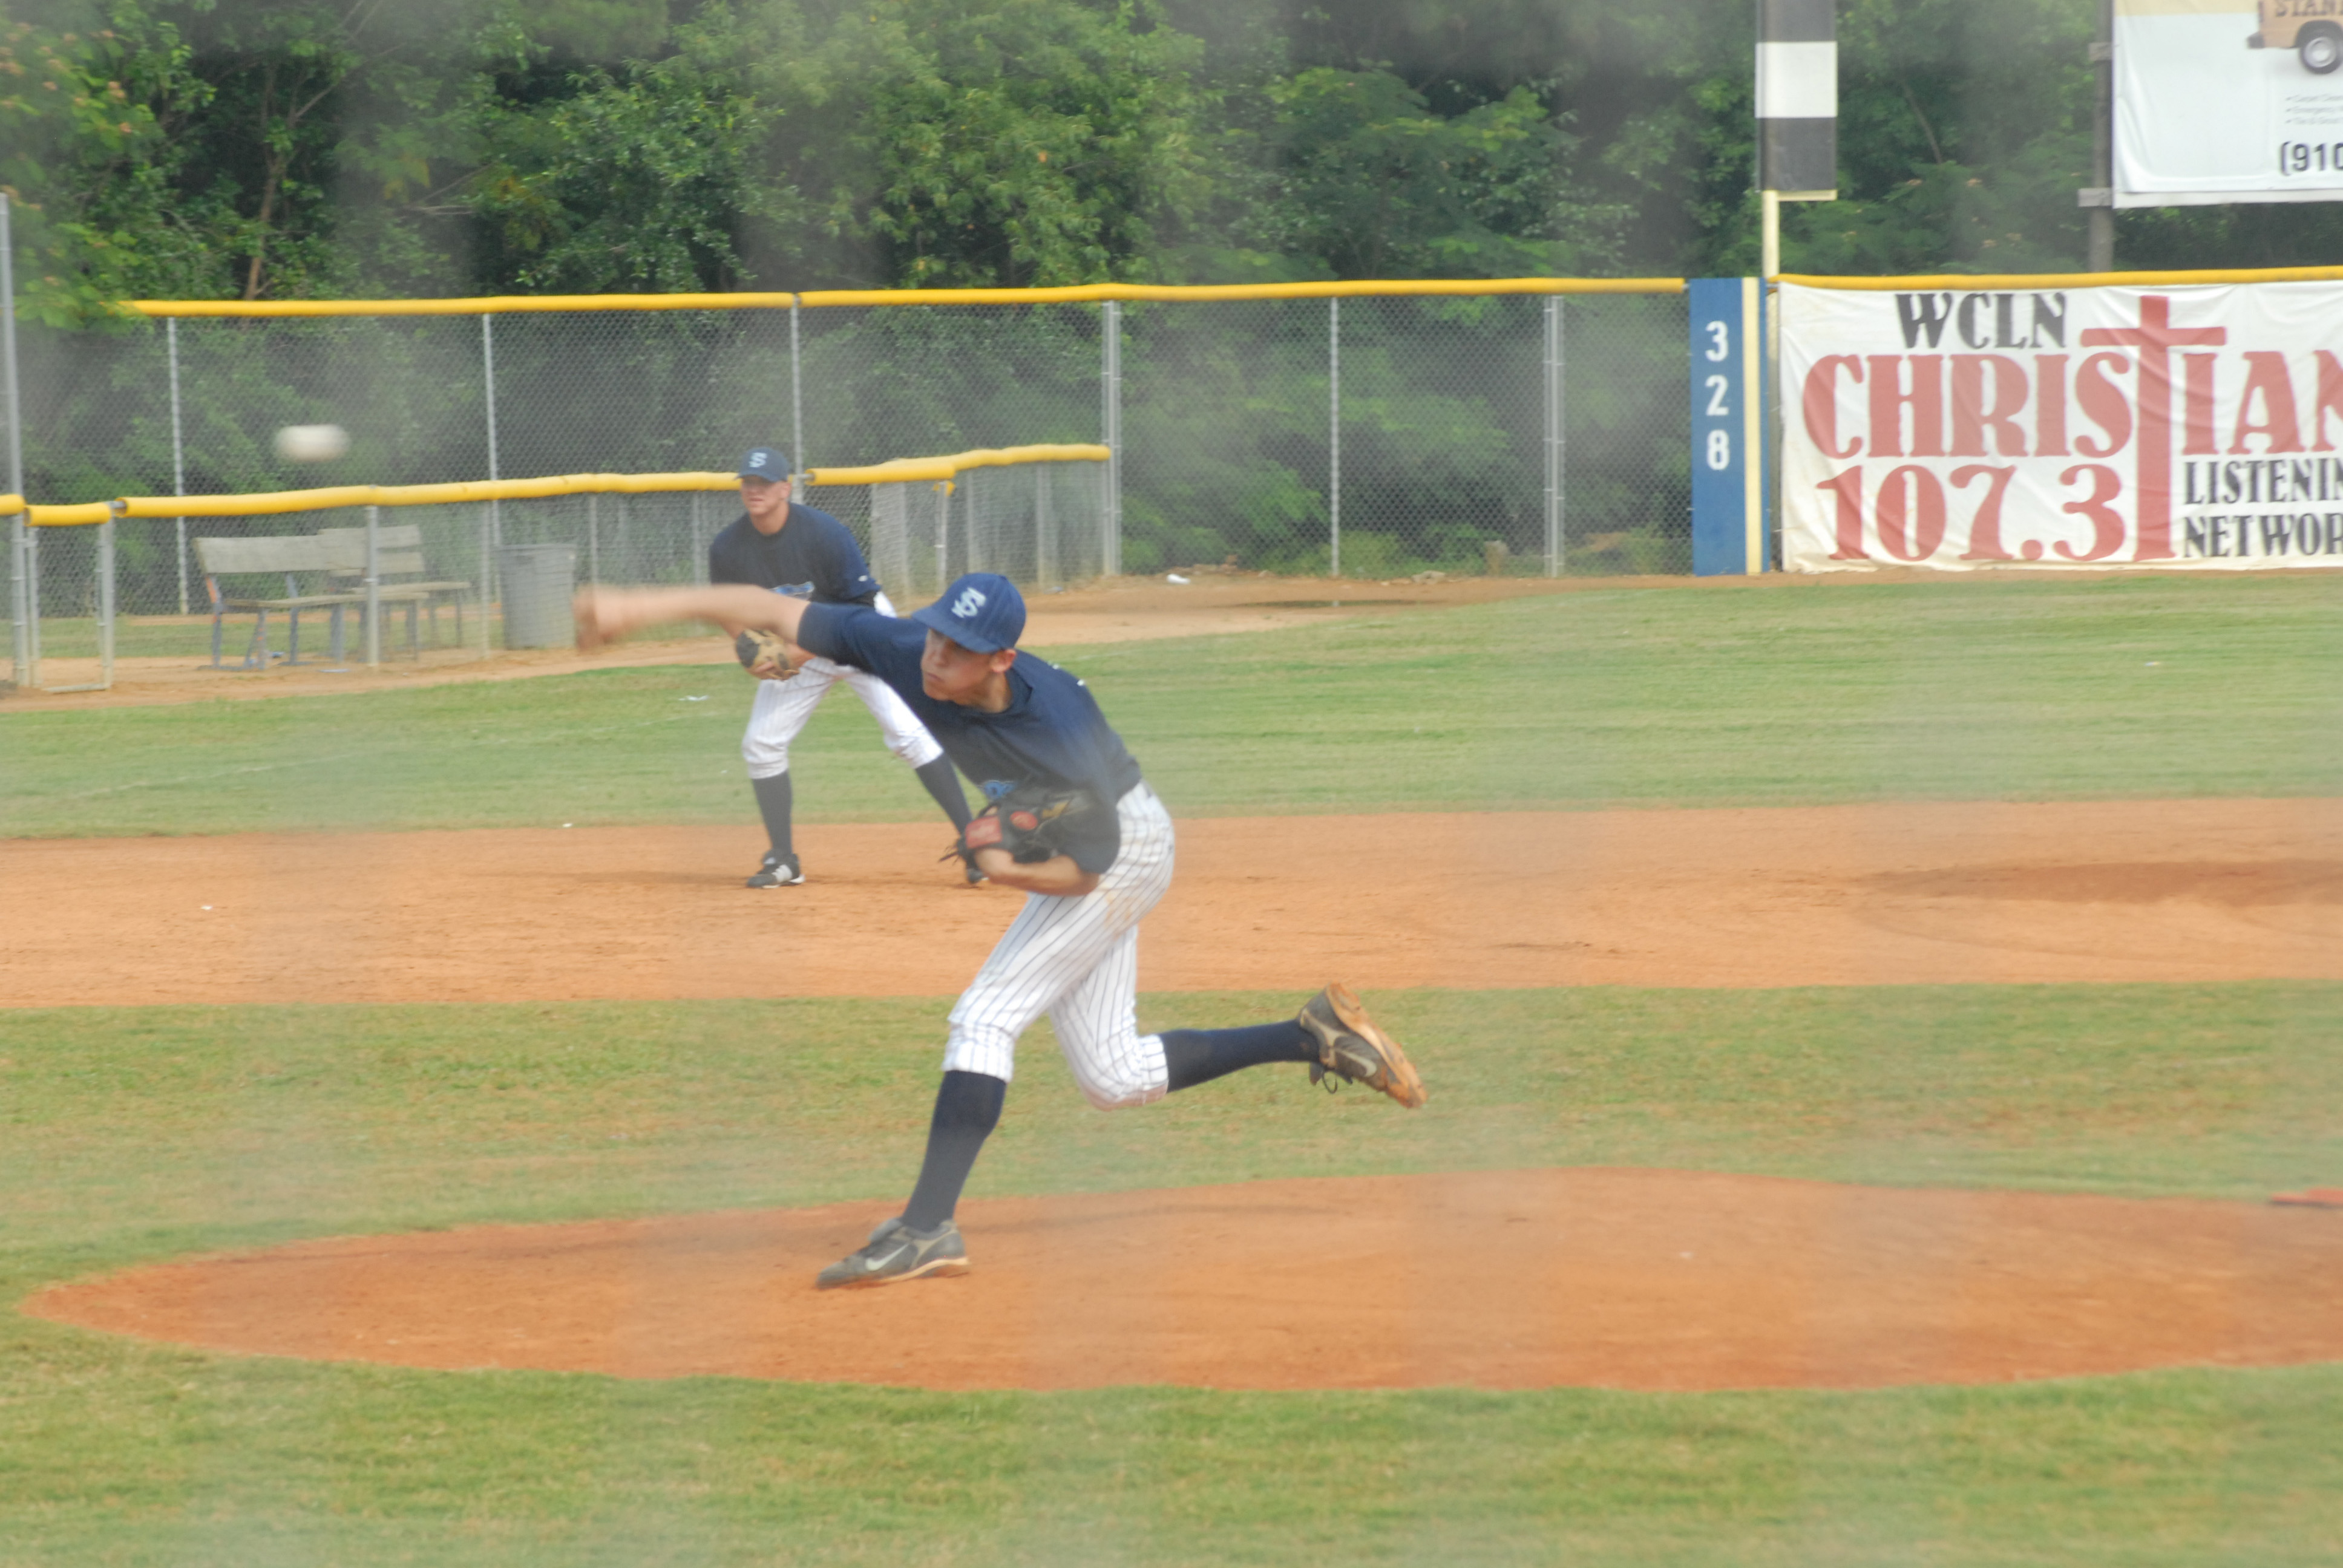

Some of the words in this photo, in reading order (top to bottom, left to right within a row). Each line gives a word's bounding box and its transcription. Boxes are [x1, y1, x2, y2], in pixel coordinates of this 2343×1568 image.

[2275, 0, 2343, 17] STAN
[1895, 293, 2067, 349] WCLN
[1816, 463, 2126, 561] 107.3
[2183, 512, 2343, 558] NETWOR
